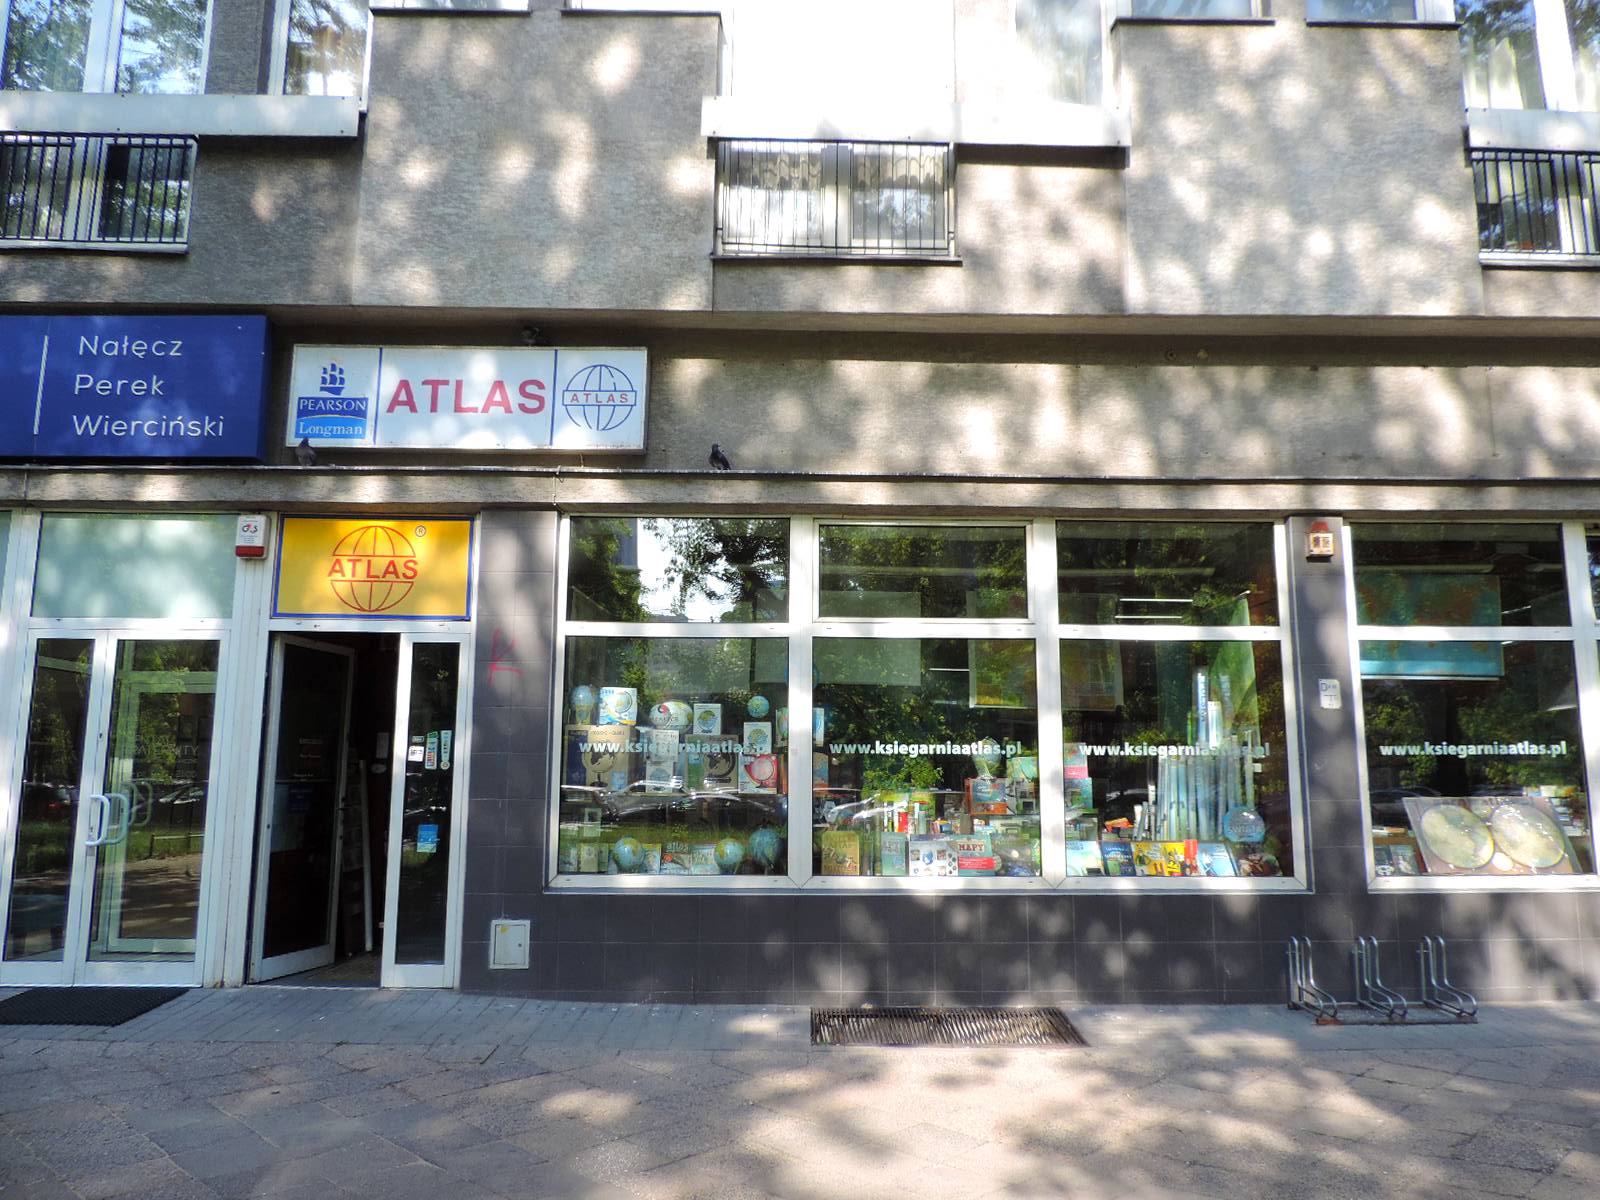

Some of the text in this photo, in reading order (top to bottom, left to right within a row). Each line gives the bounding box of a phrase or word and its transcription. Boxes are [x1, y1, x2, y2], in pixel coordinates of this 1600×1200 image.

[79, 335, 183, 358] Nałęcz
[74, 374, 164, 395] Perek
[299, 399, 366, 411] PEARSON
[386, 379, 546, 414] ATLAS
[570, 393, 629, 403] ATLAS
[72, 414, 225, 437] Wierciński
[298, 422, 363, 437] Longman
[328, 558, 418, 579] ATLAS
[829, 741, 1021, 757] www.ksiegarniaatlas.pl
[1379, 741, 1567, 758] www.ksiegarniaatlas.pl
